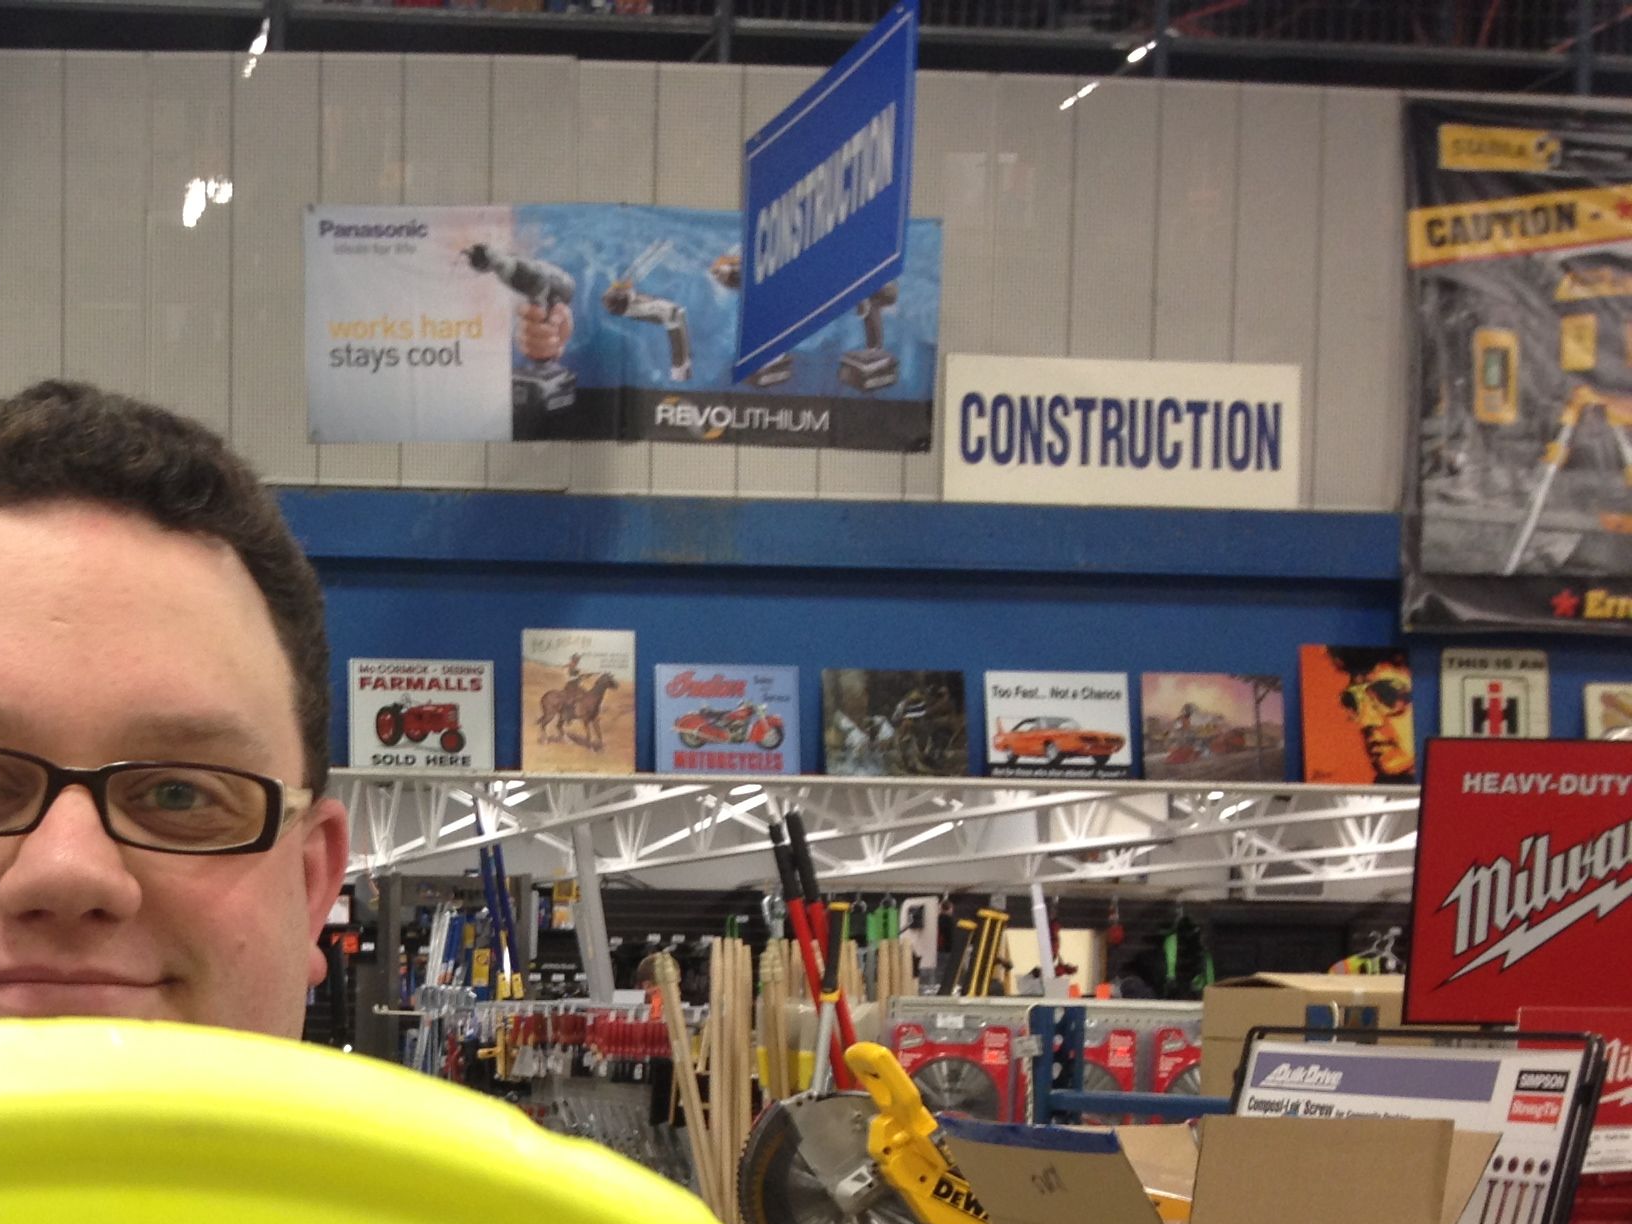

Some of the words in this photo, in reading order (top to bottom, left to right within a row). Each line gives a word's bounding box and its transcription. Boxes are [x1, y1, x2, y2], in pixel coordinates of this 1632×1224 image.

[753, 101, 897, 285] CONSTRUCTION
[319, 219, 428, 238] Panasonic
[1426, 202, 1577, 248] CAUTION
[329, 314, 413, 340] works
[421, 313, 483, 340] hard
[329, 343, 401, 373] stays
[406, 340, 463, 367] cool
[960, 391, 1283, 472] CONSTRUCTION
[359, 677, 483, 691] FARMALLS
[371, 753, 417, 766] SOLD
[426, 754, 472, 767] HERE
[1461, 771, 1632, 797] HEAVY-DUTY
[1517, 1072, 1567, 1090] SIMPSON
